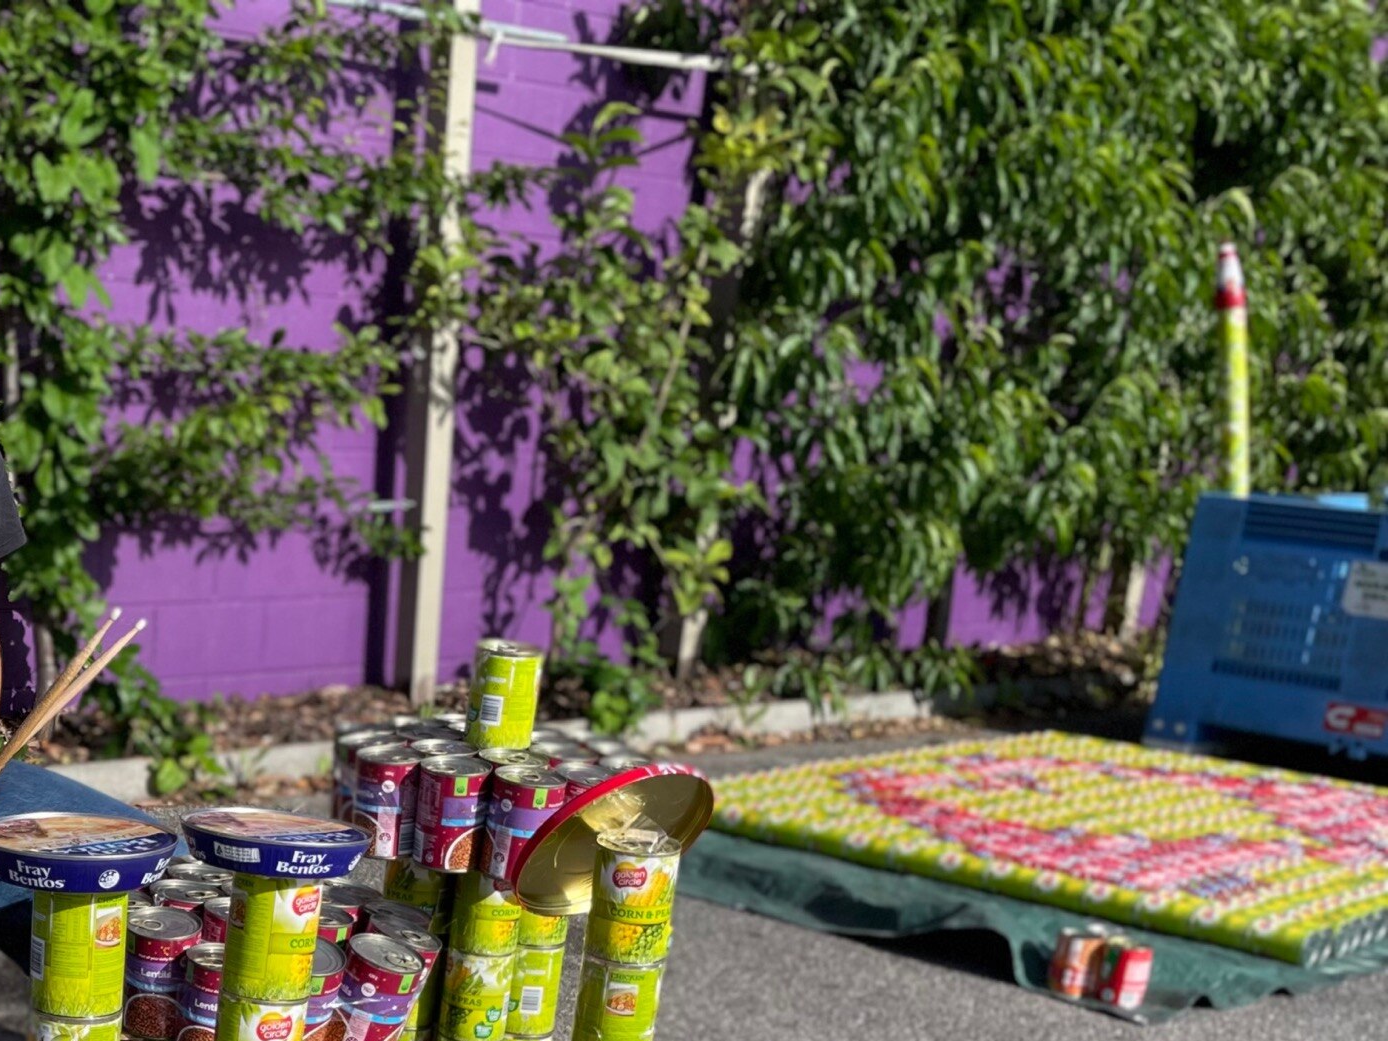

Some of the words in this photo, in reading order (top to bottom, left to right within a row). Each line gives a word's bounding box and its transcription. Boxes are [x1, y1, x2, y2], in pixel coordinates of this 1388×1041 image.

[291, 850, 327, 868] Fray
[16, 859, 51, 880] Fray
[275, 861, 333, 875] Bentos
[8, 869, 65, 889] Bentos
[614, 870, 645, 882] golden
[611, 908, 644, 919] CORN
[141, 968, 172, 979] Lentils
[258, 1021, 292, 1035] golden
[263, 1029, 289, 1040] circle
